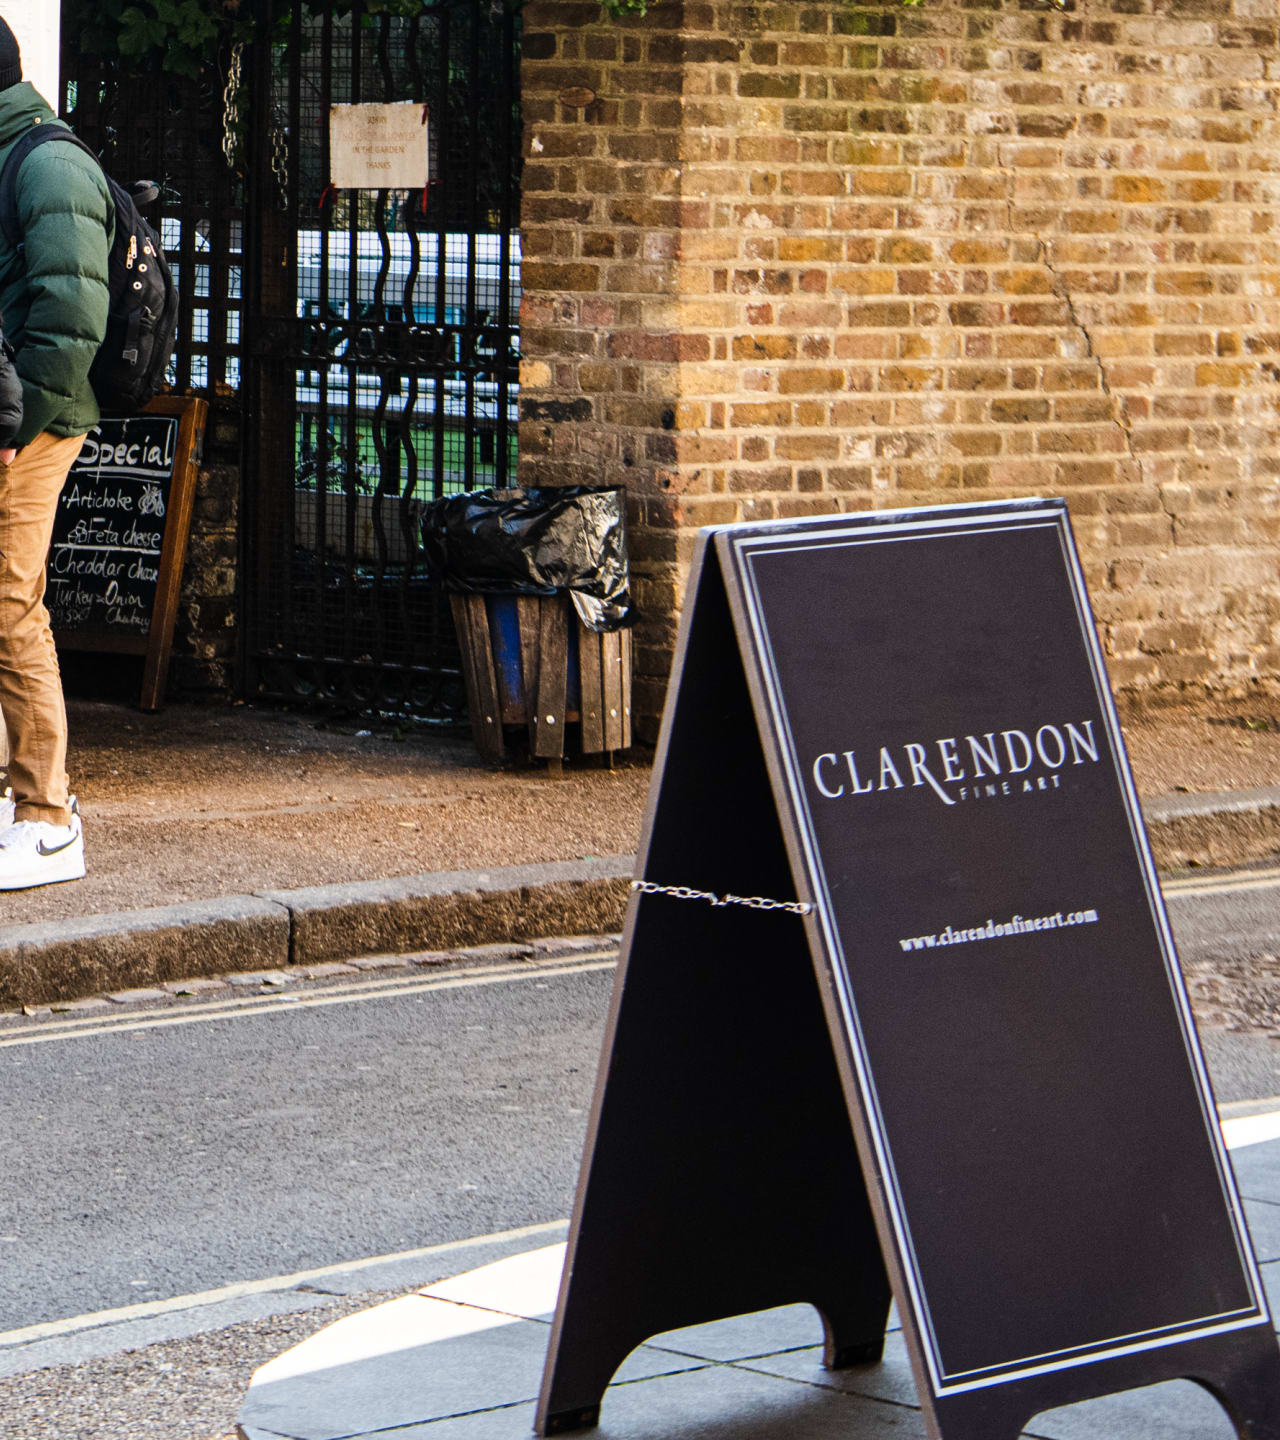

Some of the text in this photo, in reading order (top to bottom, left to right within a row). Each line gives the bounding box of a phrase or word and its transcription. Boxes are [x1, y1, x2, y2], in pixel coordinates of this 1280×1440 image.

[77, 423, 172, 484] Special
[66, 483, 133, 511] Artichoke
[54, 548, 125, 578] Cheddar
[105, 580, 146, 608] Onion
[812, 720, 1100, 805] CLARENDON
[959, 775, 1060, 800] FINE ART
[899, 909, 1100, 952] www.clarendonfineart.com
